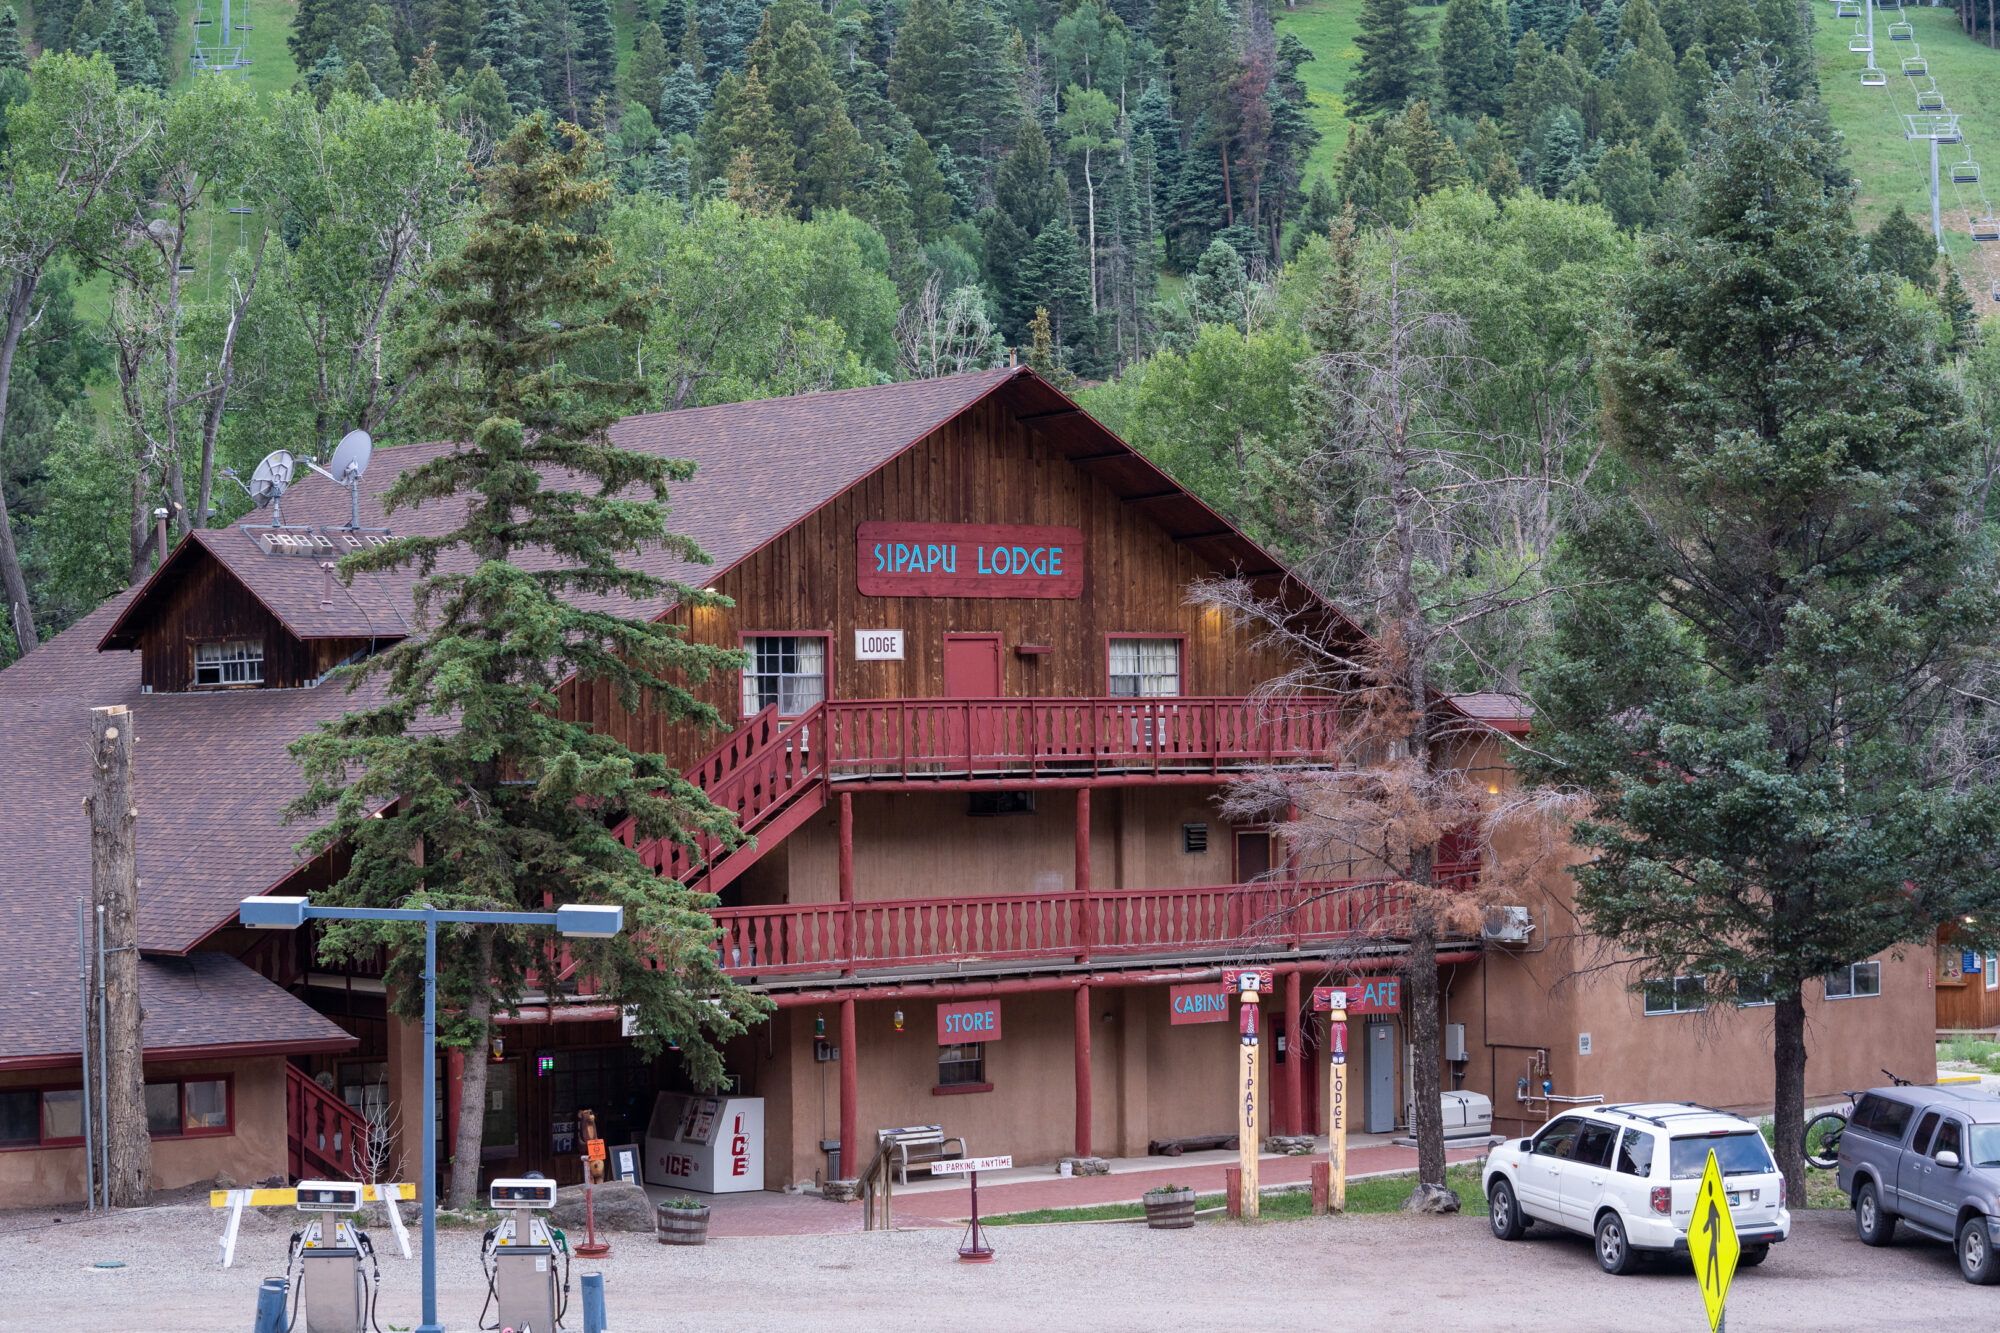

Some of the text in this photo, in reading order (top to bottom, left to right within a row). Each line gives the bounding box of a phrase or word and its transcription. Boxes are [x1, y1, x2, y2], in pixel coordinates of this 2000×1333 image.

[874, 543, 1063, 576] SIPAPU LODGE
[862, 636, 897, 653] LODGE
[1174, 993, 1226, 1014] CABINS
[1354, 982, 1397, 1007] AFE
[945, 1011, 994, 1033] STORE
[1246, 1053, 1254, 1128] SIPAPU
[1334, 1068, 1343, 1129] LODGE
[731, 1112, 750, 1177] ICE
[665, 1153, 693, 1177] ICE
[933, 1157, 1011, 1173] NO PARKING ANYTIME
